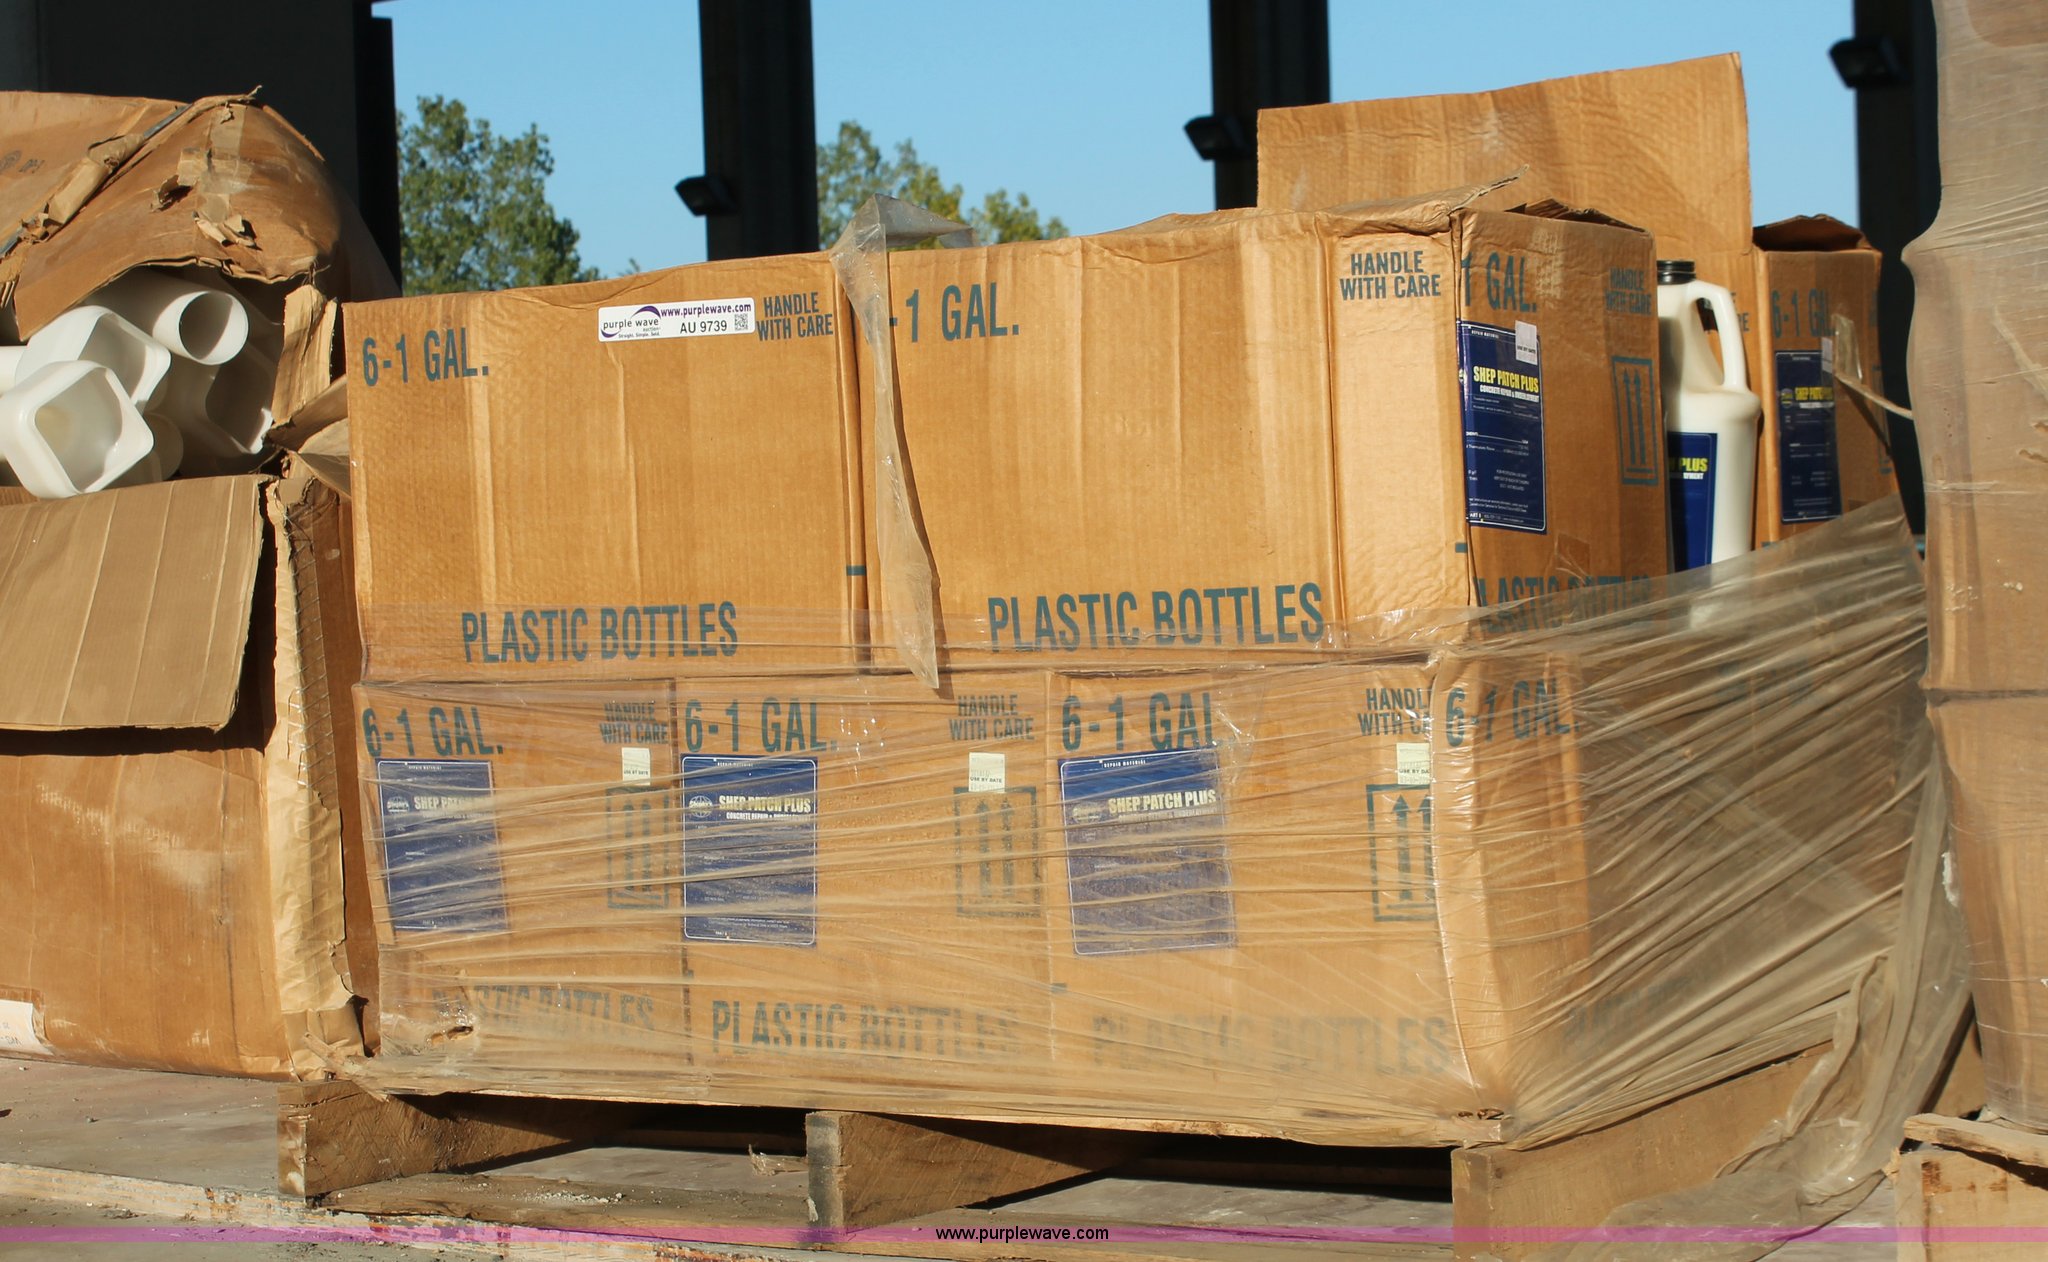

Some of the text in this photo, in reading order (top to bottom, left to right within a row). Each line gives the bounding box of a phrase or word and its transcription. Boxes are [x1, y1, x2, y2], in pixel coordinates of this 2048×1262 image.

[1350, 250, 1424, 275] HANDLE
[1339, 272, 1441, 301] WITH CARE
[1487, 251, 1537, 313] GAL.
[661, 303, 752, 318] www.purplewave.com
[764, 292, 819, 317] HANDLE
[889, 281, 1020, 342] -1 GAL.
[1771, 289, 1801, 338] 6-1
[603, 318, 659, 330] purple wave
[680, 320, 727, 334] AU 9739
[756, 313, 834, 341] WITH CARE
[362, 327, 489, 387] 6-1 GAL.
[1473, 365, 1539, 393] SHEP PATCH PLUS
[1680, 457, 1708, 472] PLUS
[987, 581, 1325, 654] PLASTIC BOTTLES
[1476, 575, 1562, 632] LASTIC
[461, 600, 738, 663] PLASTIC BOTTLES
[604, 702, 655, 721] HANDLE
[958, 694, 1018, 717] HANDLE
[1446, 679, 1580, 747] 6-1 GAL.
[362, 706, 503, 758] 6-1 GAL.
[600, 721, 668, 744] WITH CARE
[685, 697, 837, 753] 6-1 GAL.
[949, 717, 1035, 741] WITH CARE
[1061, 694, 1125, 751] 6-1
[1358, 712, 1431, 736] WITH CA
[413, 796, 439, 810] SHEP
[719, 795, 745, 811] SHEP
[747, 796, 781, 812] PATCH
[784, 797, 811, 813] PLUS
[1108, 796, 1141, 813] SHEP
[1143, 792, 1183, 811] PATCH
[1185, 789, 1217, 807] PLUS
[712, 1000, 848, 1056] PLASTIC
